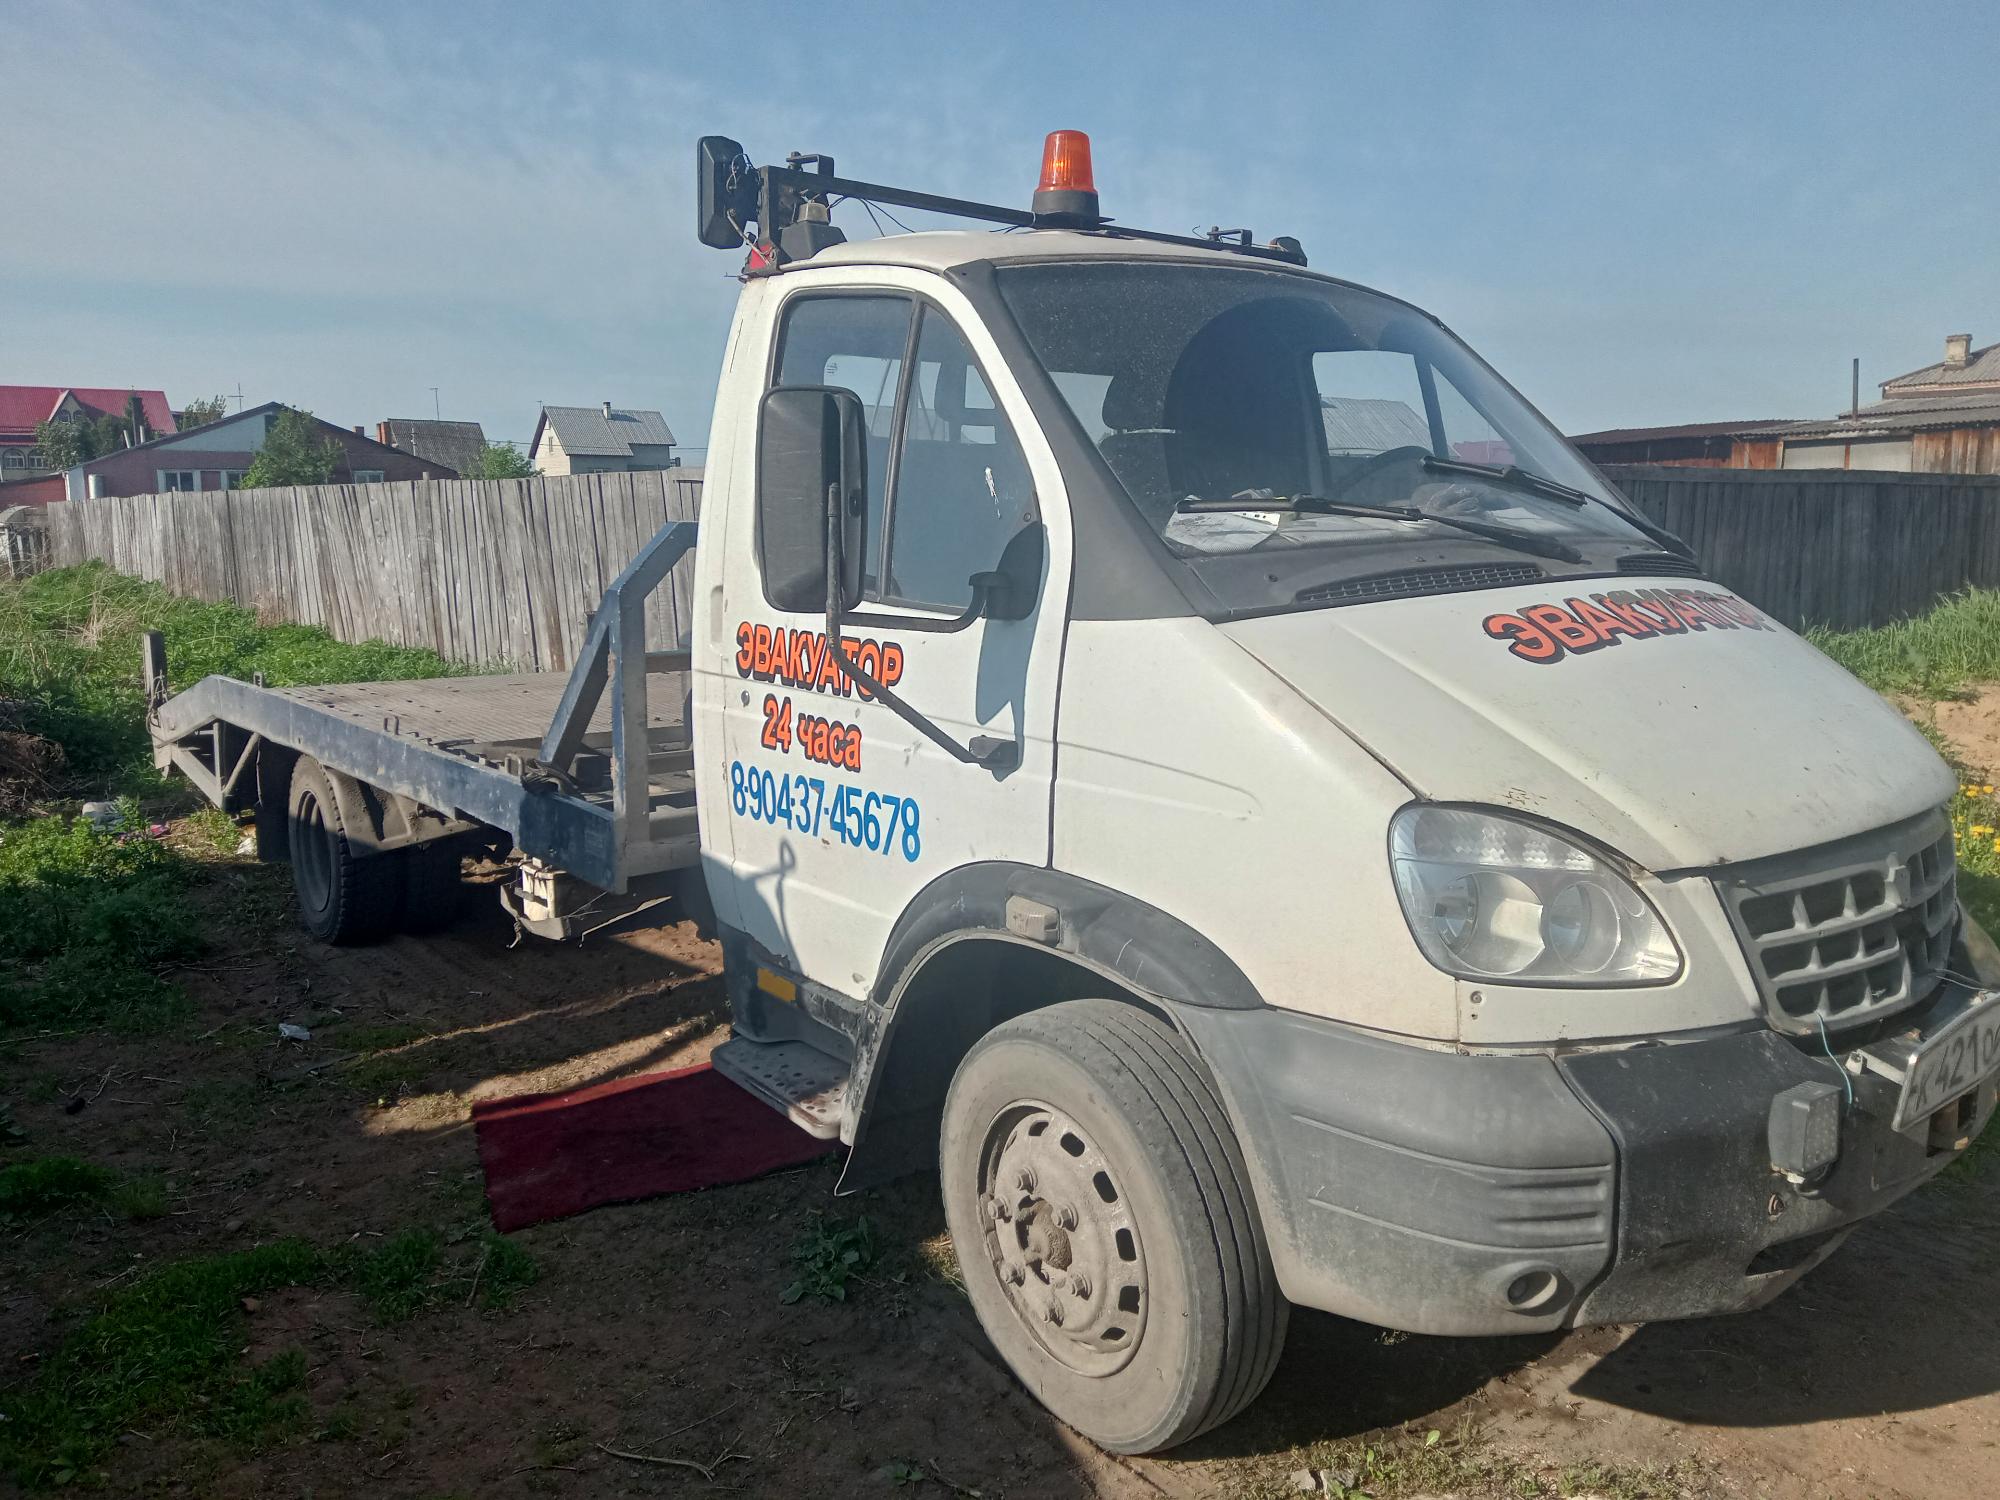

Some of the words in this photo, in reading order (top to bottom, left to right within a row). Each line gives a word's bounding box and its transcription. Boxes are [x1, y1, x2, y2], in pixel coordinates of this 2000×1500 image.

[736, 621, 904, 701] ЭВАКУАТОР
[761, 693, 791, 754] 24
[797, 713, 861, 772] часа
